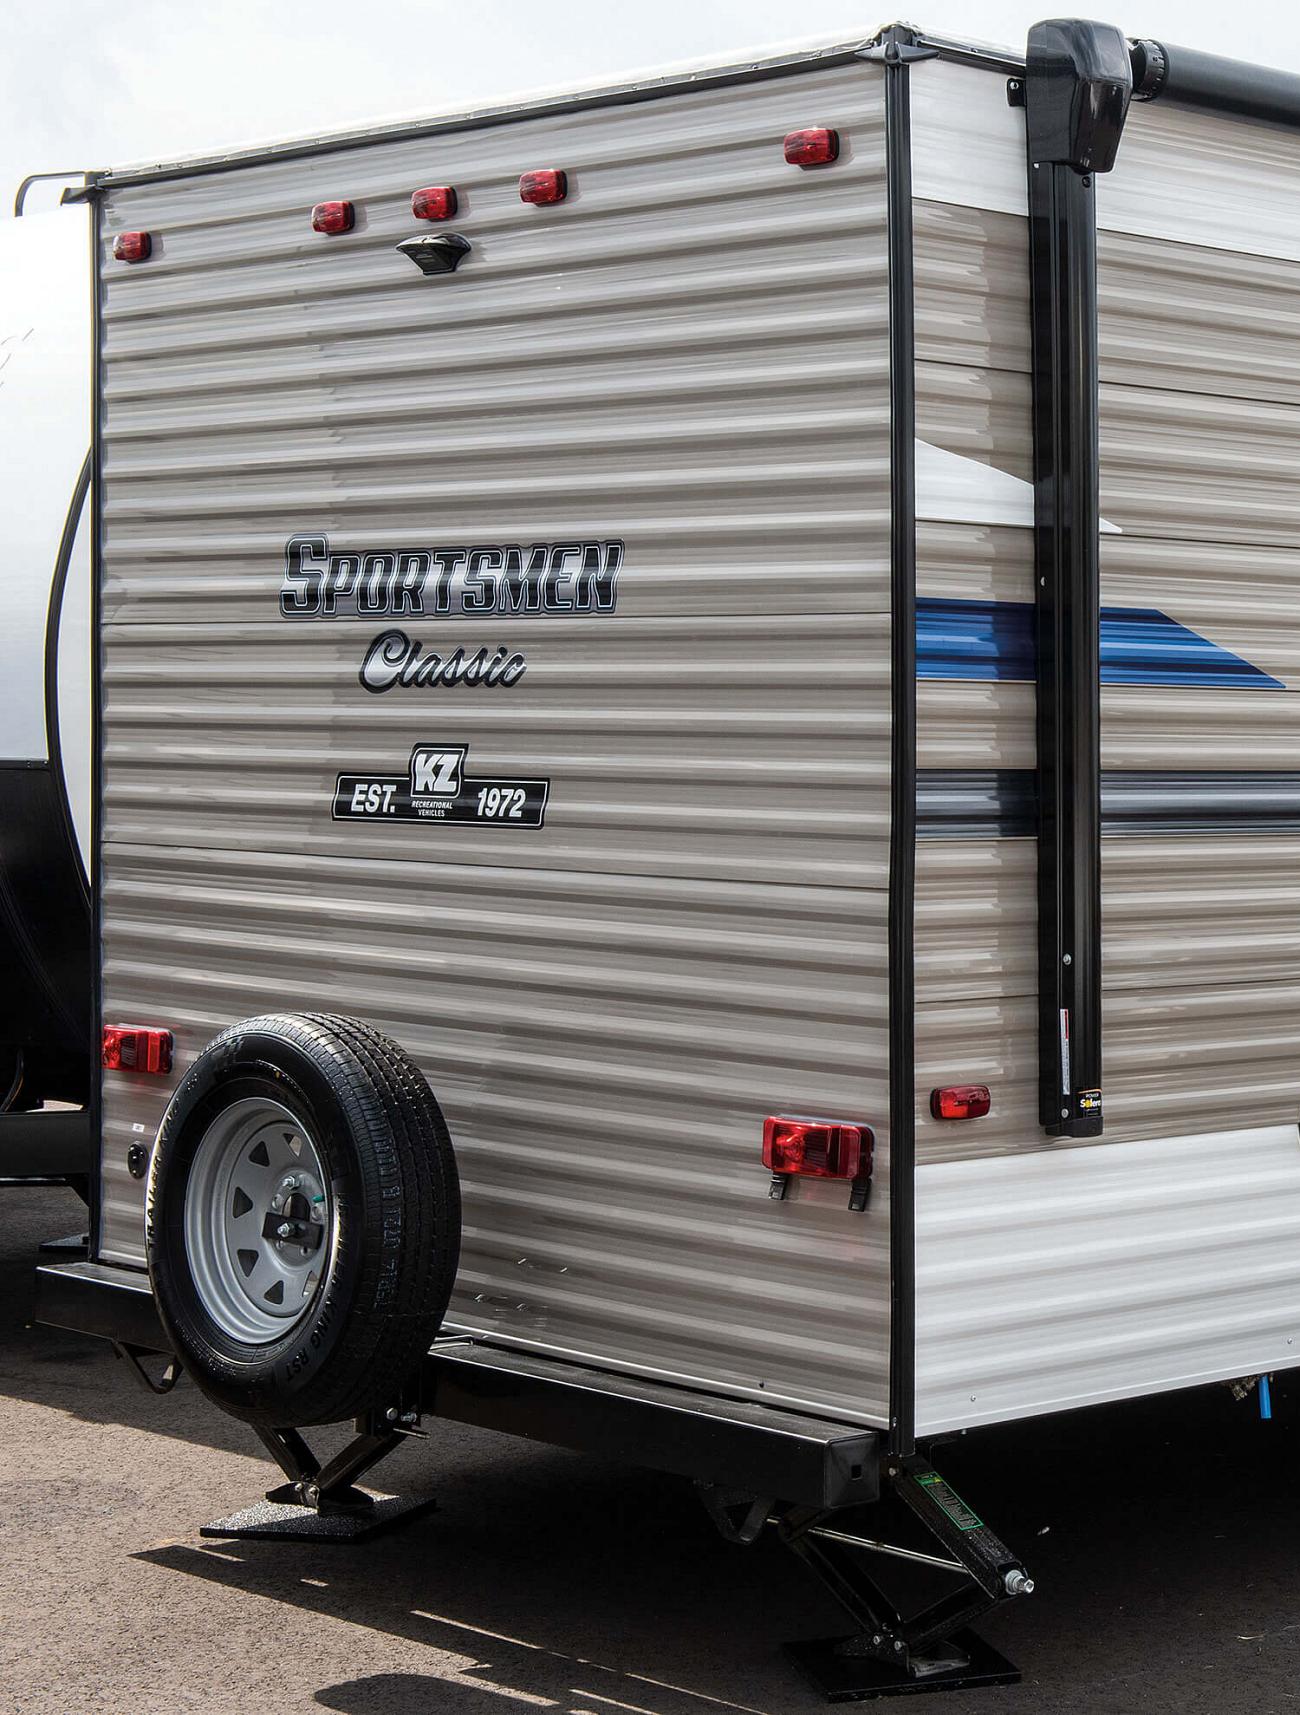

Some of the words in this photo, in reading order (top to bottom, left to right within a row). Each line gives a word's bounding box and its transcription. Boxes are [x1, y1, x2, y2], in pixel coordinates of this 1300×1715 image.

[359, 628, 527, 693] Classic
[414, 753, 460, 793] KZ
[350, 783, 397, 814] EST.
[477, 787, 526, 819] 1972
[411, 799, 453, 810] RECREATIONAL
[418, 808, 445, 817] VEHICLES
